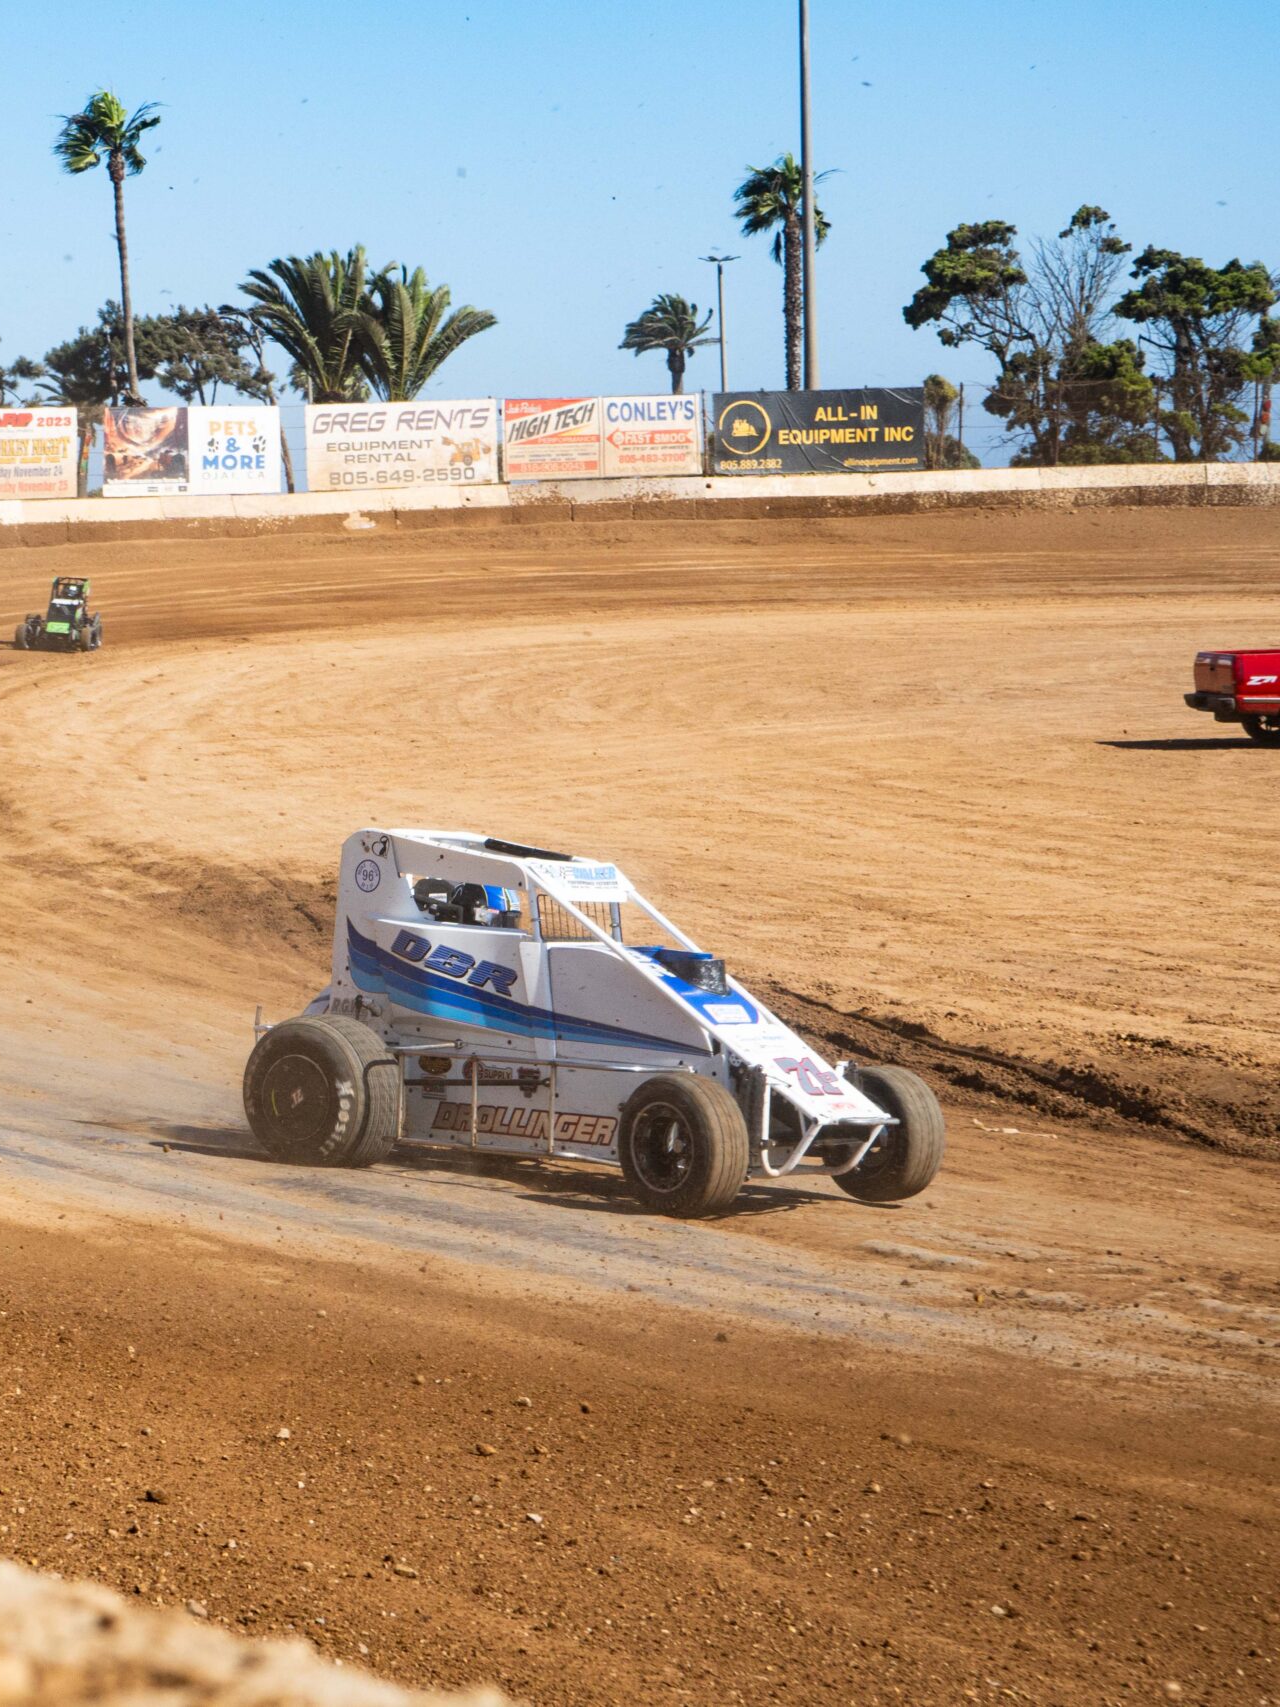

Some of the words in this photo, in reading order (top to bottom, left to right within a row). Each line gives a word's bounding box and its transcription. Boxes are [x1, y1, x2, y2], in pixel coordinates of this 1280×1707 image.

[606, 400, 695, 423] CONLEY'S
[36, 416, 72, 428] 2023
[208, 420, 258, 437] PETS
[312, 411, 388, 435] GREG
[395, 407, 491, 432] RENTS
[507, 413, 551, 443] HIGH
[554, 402, 596, 431] TECH
[624, 433, 651, 446] FAST
[654, 431, 687, 444] SMOG
[778, 427, 879, 445] EQUIPMENT
[884, 426, 915, 442] INC
[226, 437, 241, 453] &
[326, 439, 434, 453] EQUIPMENT
[202, 454, 266, 470] MORE
[344, 452, 417, 464] RENTAL
[13, 466, 52, 478] November
[53, 464, 64, 477] 24
[329, 466, 476, 486] 805-649-2590
[18, 480, 56, 492] November
[361, 869, 375, 882] 96
[390, 928, 518, 998] DBR
[430, 1100, 619, 1147] DROLLINGER
